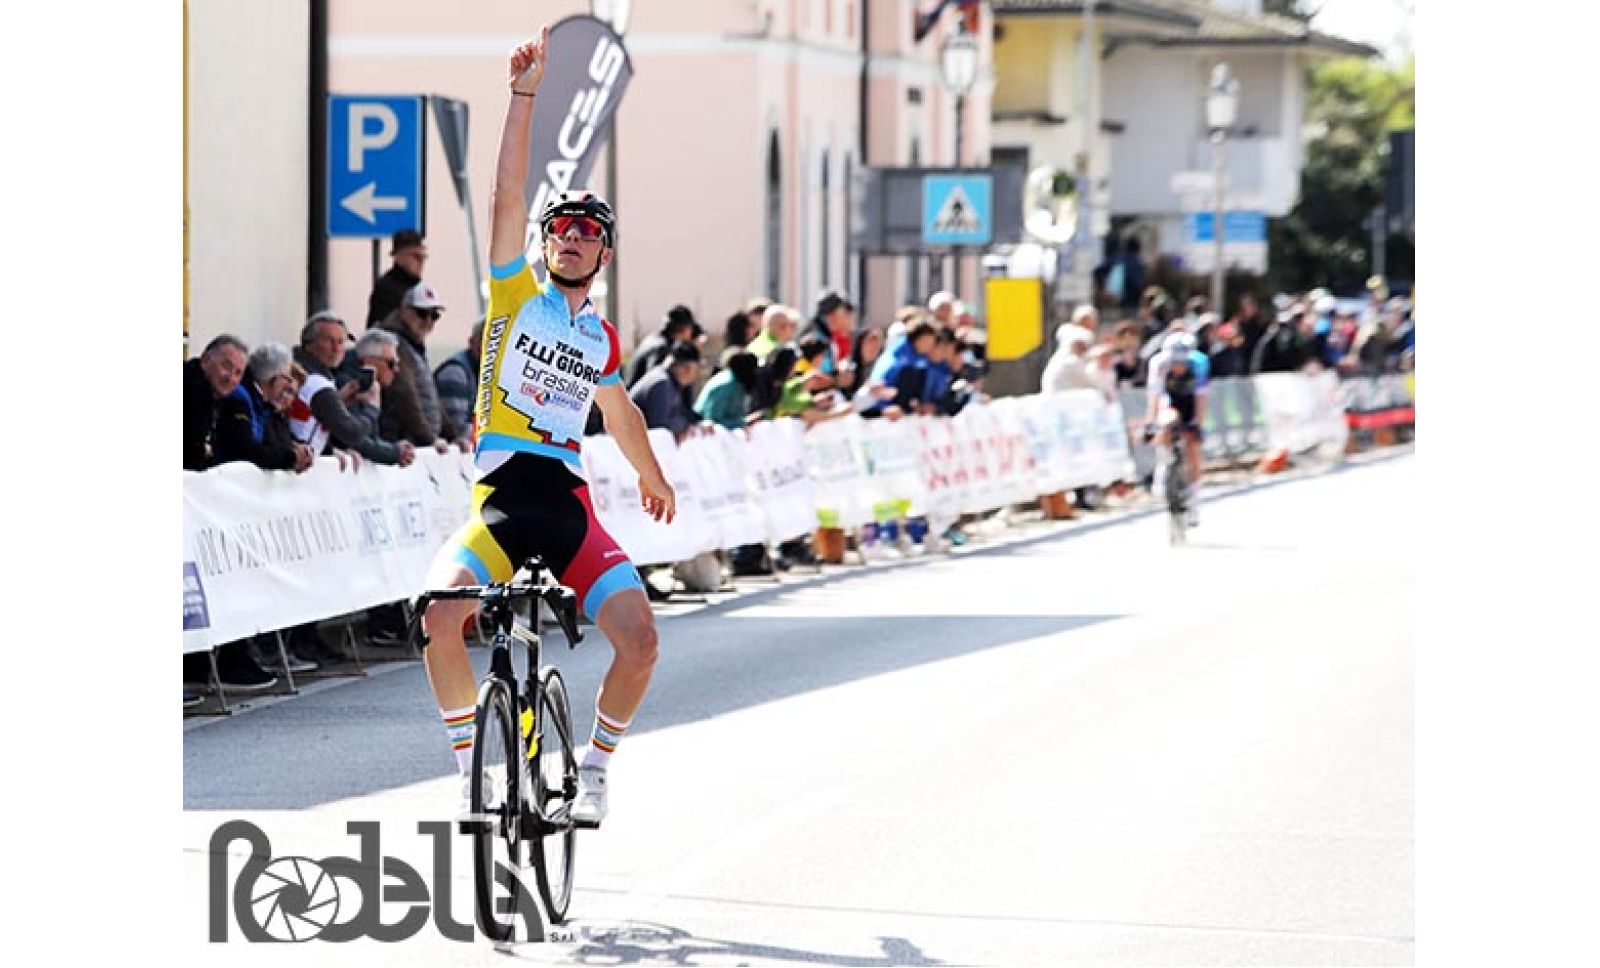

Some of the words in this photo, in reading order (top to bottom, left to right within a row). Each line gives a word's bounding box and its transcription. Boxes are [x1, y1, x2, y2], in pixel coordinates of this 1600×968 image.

[347, 102, 399, 172] P
[556, 340, 583, 359] TEAM
[523, 360, 590, 402] brasilia
